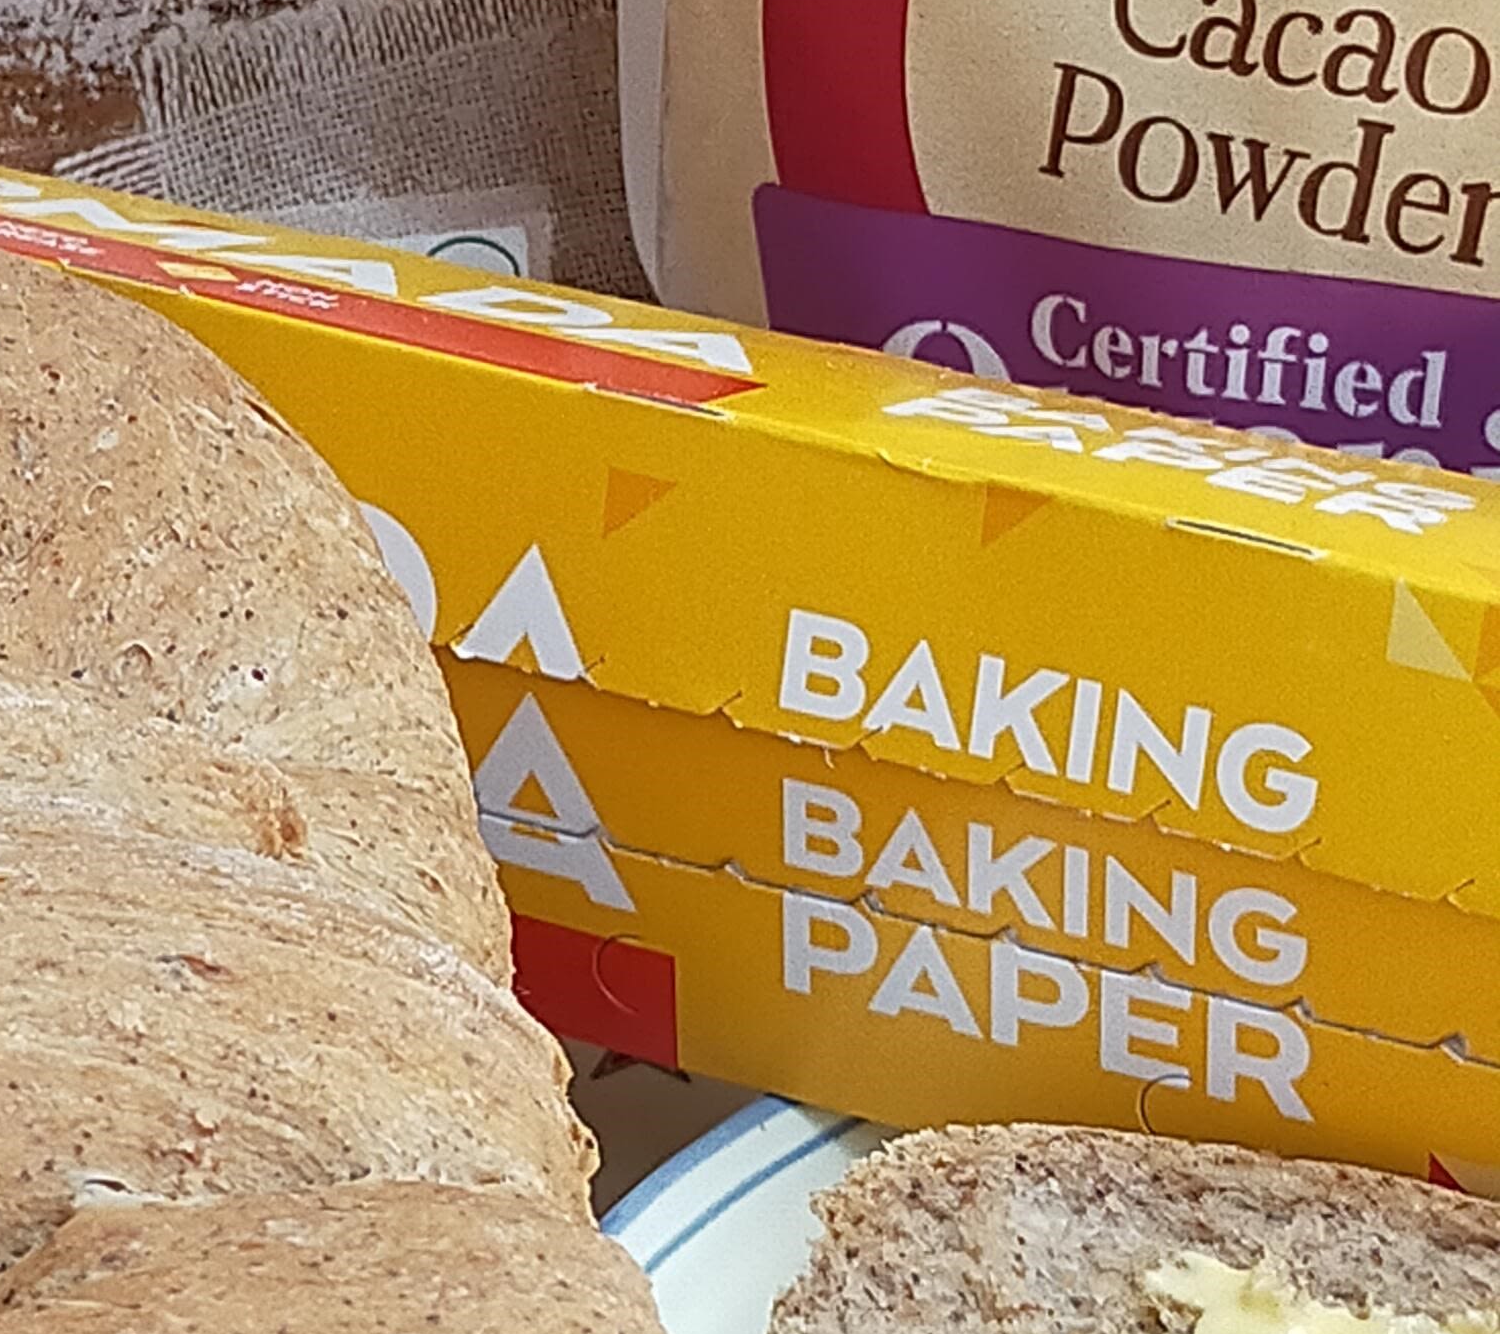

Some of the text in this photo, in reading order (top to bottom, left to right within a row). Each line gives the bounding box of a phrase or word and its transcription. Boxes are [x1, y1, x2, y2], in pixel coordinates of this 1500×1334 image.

[1037, 61, 1500, 267] Powder
[1031, 293, 1447, 430] Certified
[778, 608, 1319, 834] BAKING
[780, 776, 1308, 986] BAKING
[782, 888, 1316, 1123] PAPER
